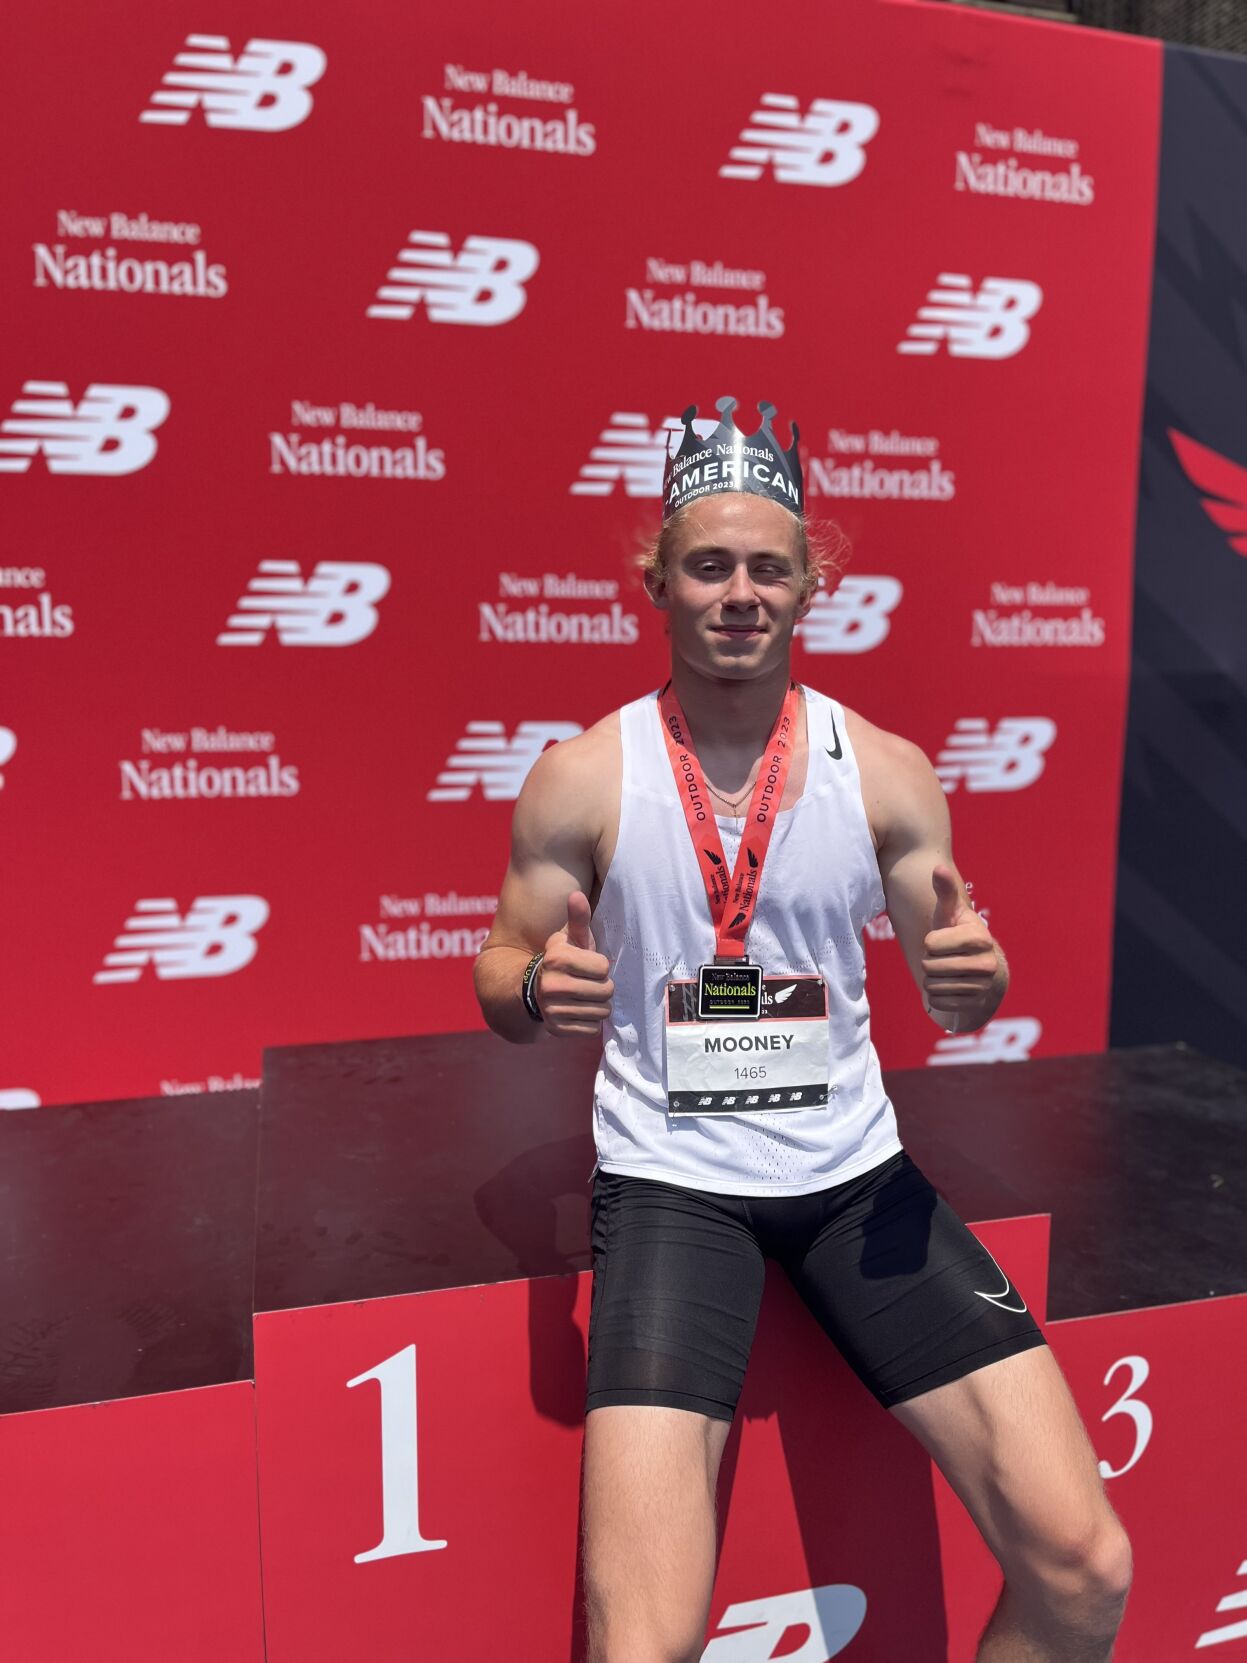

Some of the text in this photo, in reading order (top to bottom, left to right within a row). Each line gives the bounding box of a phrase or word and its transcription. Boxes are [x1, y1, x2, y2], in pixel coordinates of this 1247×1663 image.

[445, 64, 574, 104] New Balance
[422, 96, 596, 156] Nationals
[975, 123, 1078, 159] New Balance
[955, 152, 1095, 206] Nationals
[57, 209, 201, 244] New Balance
[33, 243, 228, 298] Nationals
[646, 257, 766, 291] New Balance
[625, 288, 785, 339] Nationals
[292, 401, 422, 432] New Balance
[270, 432, 446, 480] Nationals
[673, 448, 712, 477] Balance
[828, 429, 939, 457] New Balance
[675, 481, 734, 508] OUTDOOR 2023
[807, 457, 955, 501] Nationals
[499, 572, 619, 599] New Balance
[992, 582, 1090, 606] New Balance
[479, 602, 639, 644] Nationals
[971, 607, 1105, 647] Nationals
[141, 726, 275, 753] New Balance
[119, 754, 300, 800] Nationals
[669, 715, 706, 821] OUTDOOR 2023
[756, 716, 790, 823] OUTDOOR 2023
[380, 894, 421, 918] New
[739, 868, 758, 911] Nationals
[704, 982, 756, 996] Nationals
[704, 1035, 794, 1053] MOONEY
[734, 1066, 767, 1079] 1465
[1097, 1355, 1153, 1479] 3
[345, 1343, 448, 1564] 1
